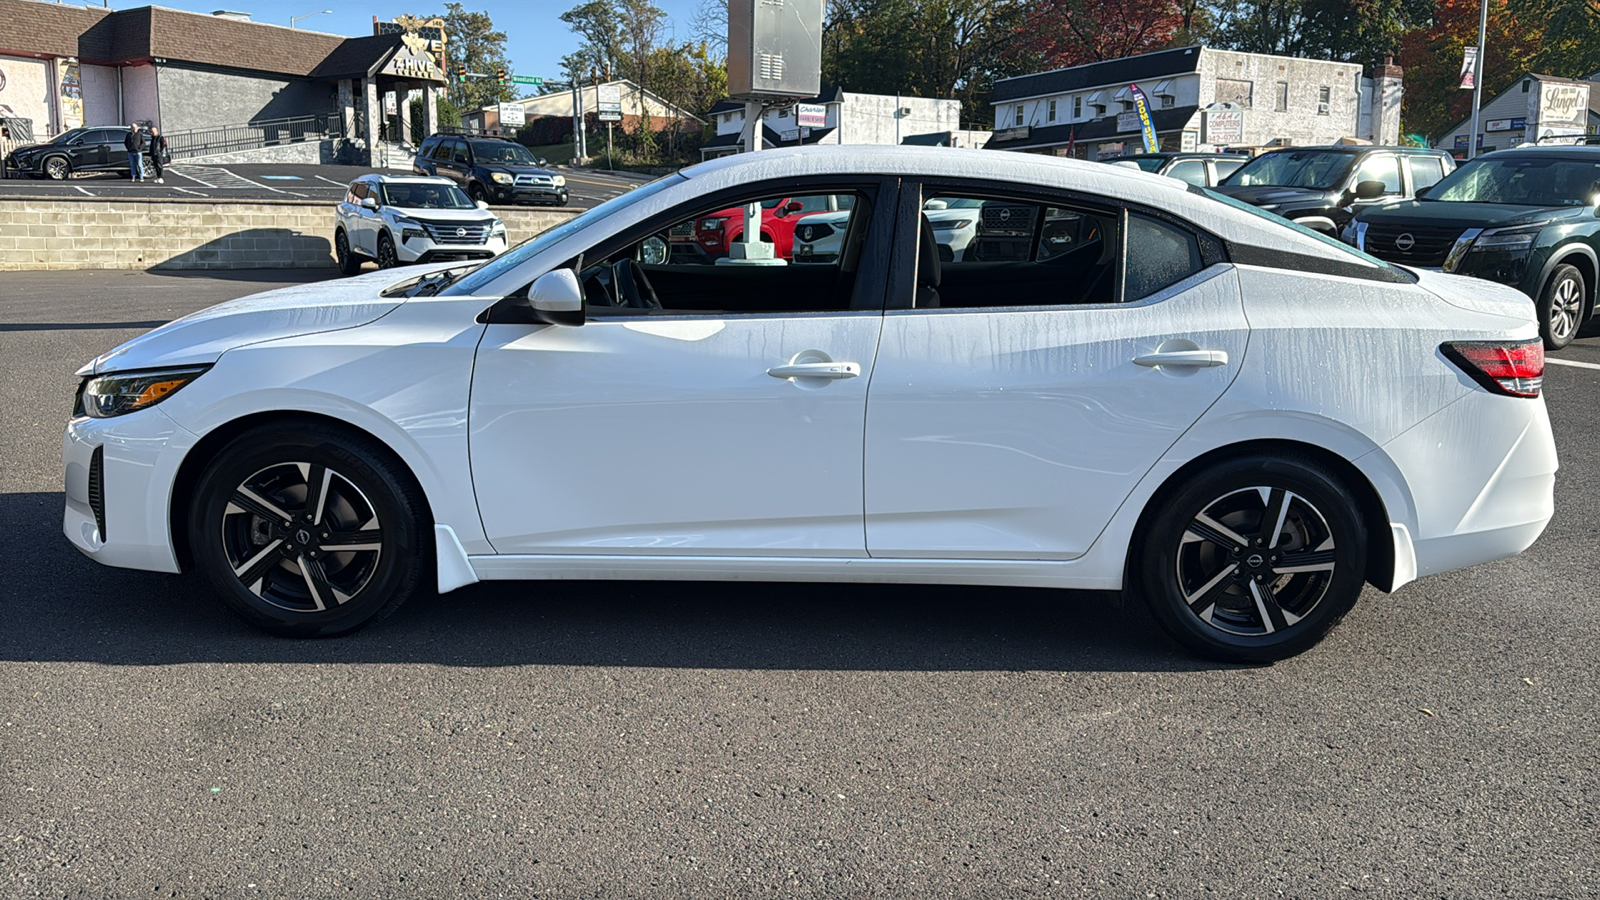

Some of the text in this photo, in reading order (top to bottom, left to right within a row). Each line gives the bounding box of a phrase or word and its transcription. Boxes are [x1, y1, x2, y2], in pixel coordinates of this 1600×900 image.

[404, 58, 434, 73] HIVE
[1543, 87, 1585, 115] Langel's
[1208, 120, 1240, 128] COMPUTERS
